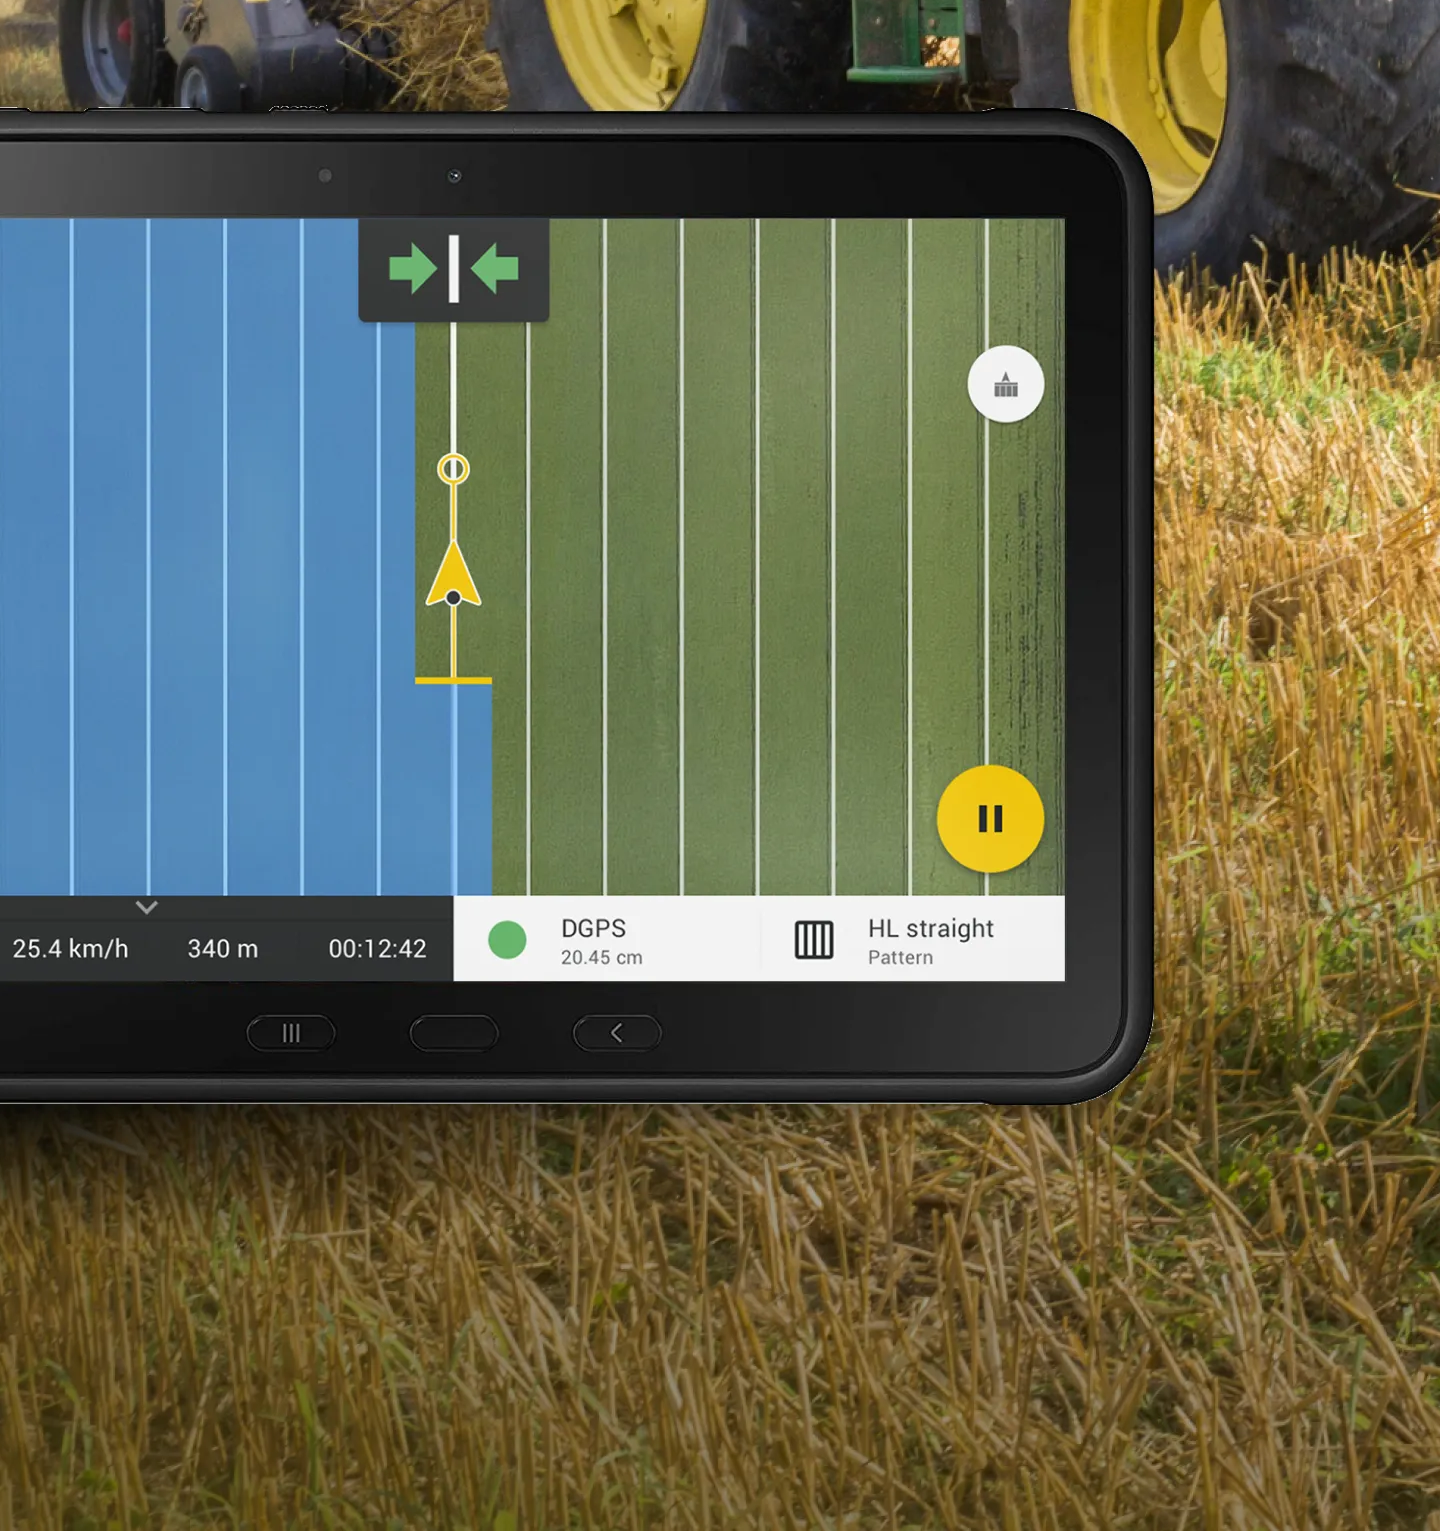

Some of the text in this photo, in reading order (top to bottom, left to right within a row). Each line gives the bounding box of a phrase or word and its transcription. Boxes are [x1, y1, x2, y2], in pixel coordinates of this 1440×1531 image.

[562, 918, 627, 939] DGPS
[869, 916, 995, 944] HL straight
[12, 937, 129, 961] 25.4 km/h
[188, 938, 258, 959] 340 m
[329, 938, 427, 959] 00:12:42
[561, 949, 643, 966] 20.45 cm
[868, 949, 933, 966] Pattern
